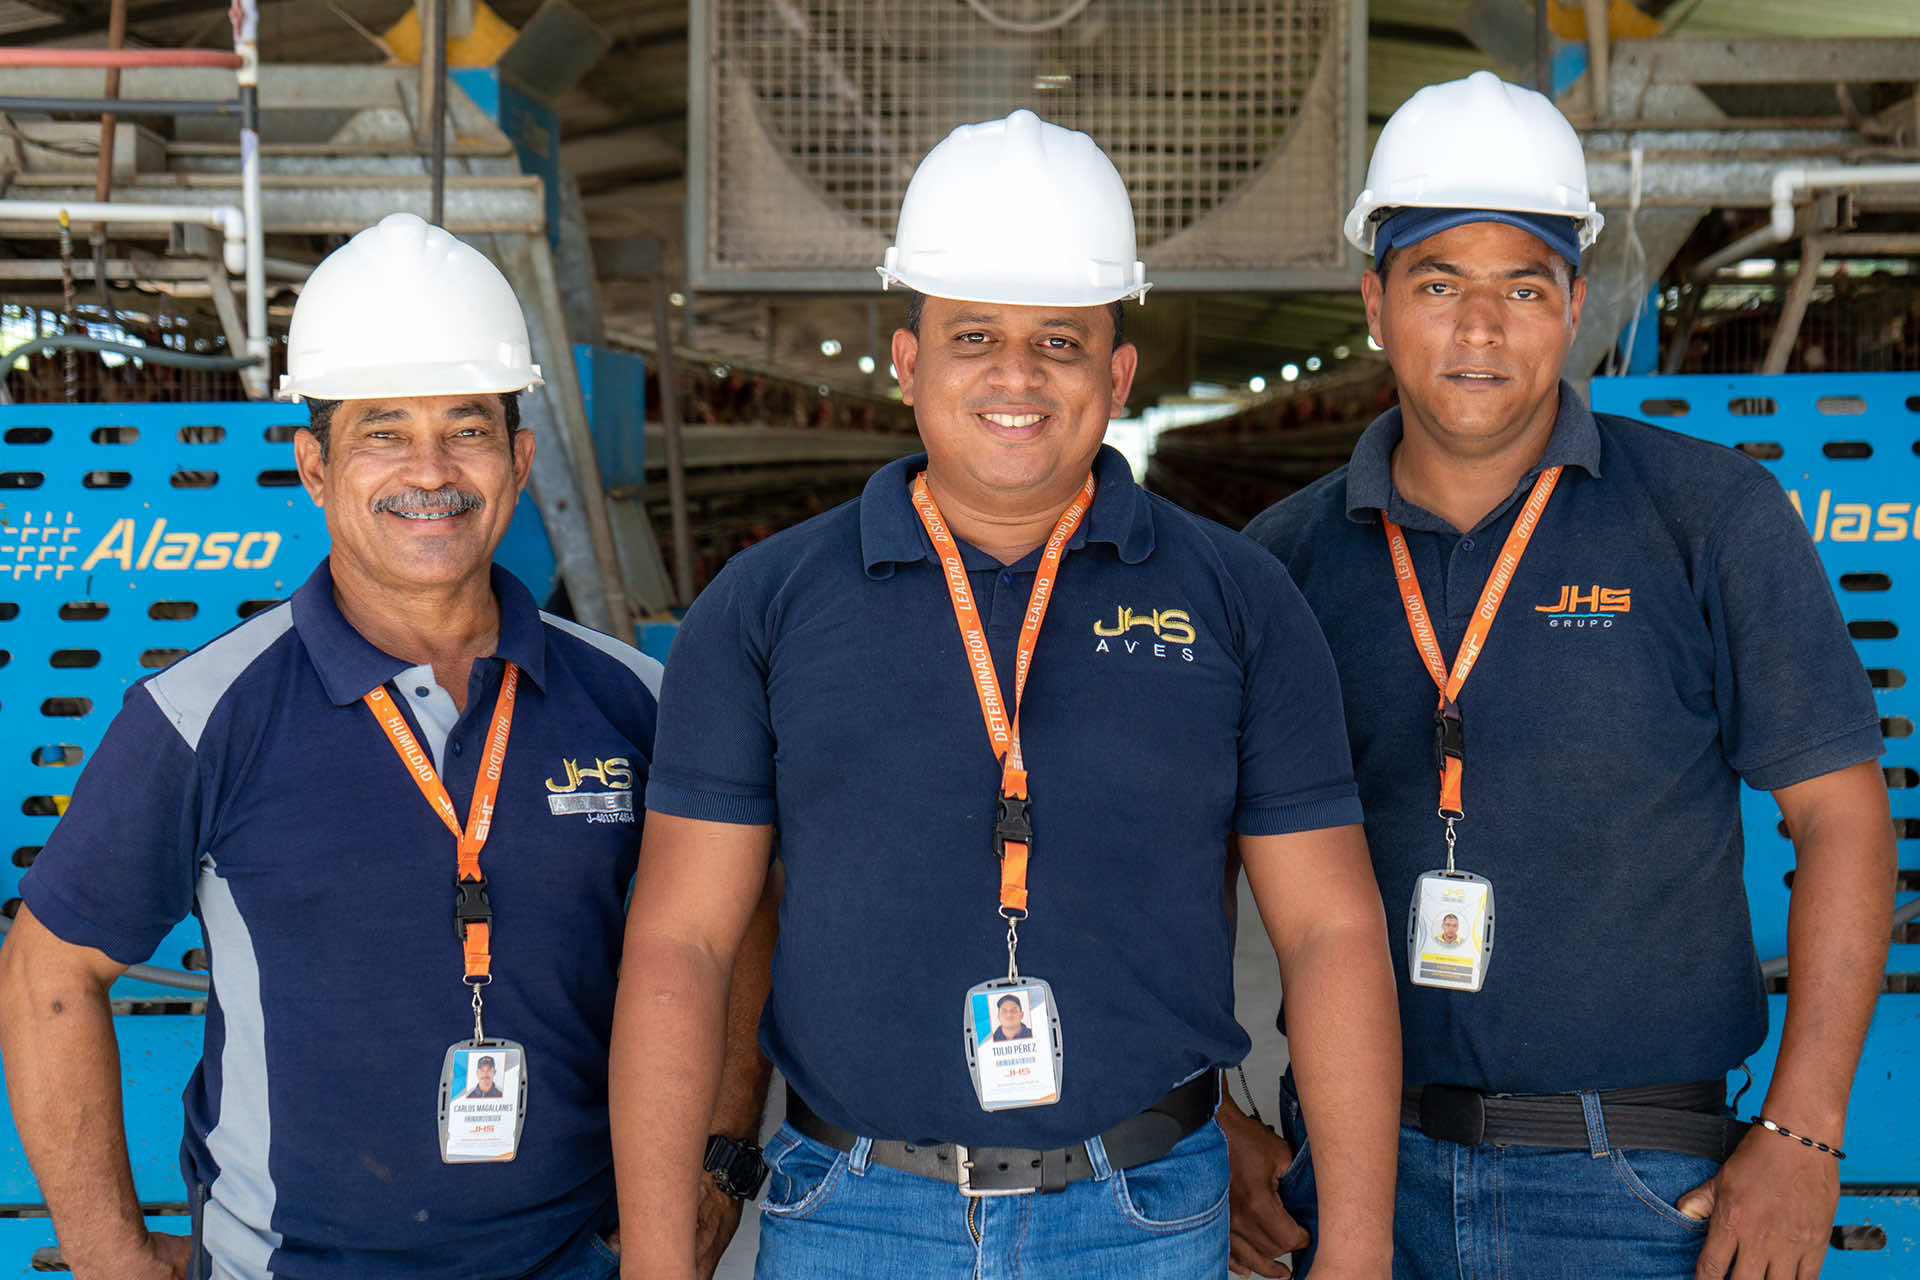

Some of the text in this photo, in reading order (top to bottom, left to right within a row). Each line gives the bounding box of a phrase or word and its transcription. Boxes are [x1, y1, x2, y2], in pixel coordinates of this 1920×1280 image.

[1784, 489, 1920, 542] las
[81, 518, 282, 570] Alaso
[1025, 576, 1050, 631] LEALTAD
[1046, 503, 1083, 561] DISCIPLINA
[1391, 535, 1412, 580] LEALTAD
[1480, 552, 1517, 620] HUMILDAD
[1534, 584, 1631, 613] JHS
[913, 489, 1010, 742] DETERMINACIÓN LEALTAD DISCIPLINA
[1549, 619, 1614, 629] GRUPO
[1096, 638, 1195, 663] AVES
[387, 716, 434, 783] HUMILDAD
[486, 714, 510, 782] HUMILDAD
